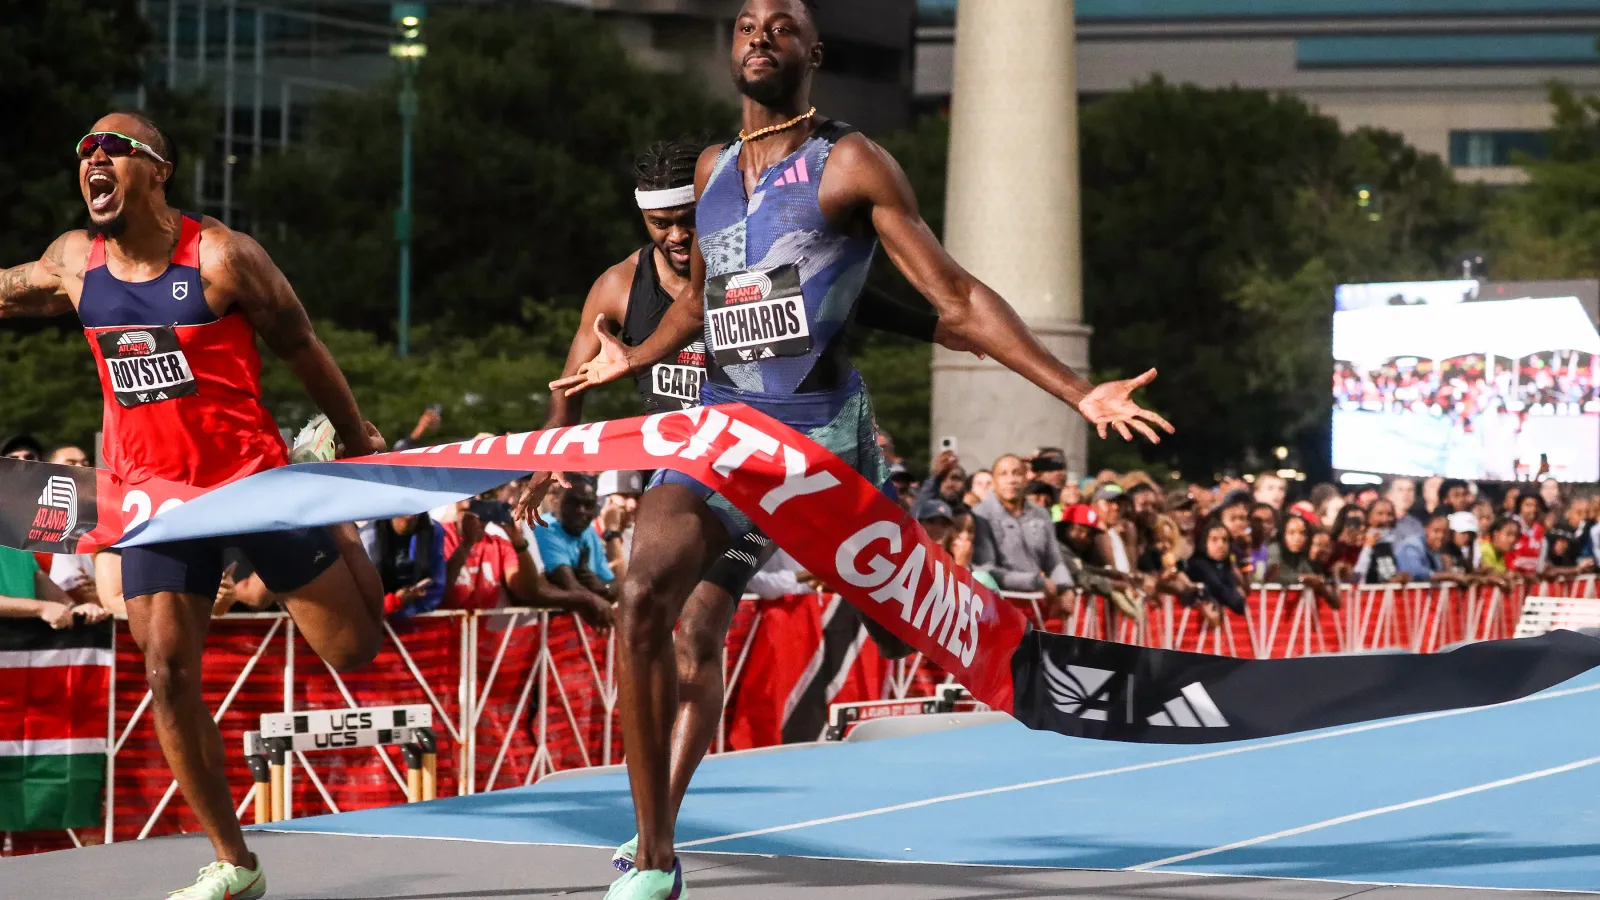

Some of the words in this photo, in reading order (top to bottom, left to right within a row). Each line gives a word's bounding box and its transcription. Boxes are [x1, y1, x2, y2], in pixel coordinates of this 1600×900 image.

[725, 285, 761, 299] ATLANTA
[739, 294, 762, 303] GAMES
[711, 300, 800, 346] RICHARDS
[118, 342, 149, 353] ATLANTA
[111, 354, 186, 389] ROYSTER
[32, 507, 68, 531] ATLANTA
[28, 529, 42, 540] CITY
[42, 531, 62, 543] GAMES
[640, 406, 843, 516] CITY
[835, 520, 984, 668] GAMES
[330, 712, 373, 731] UCS
[315, 732, 358, 748] UCS
